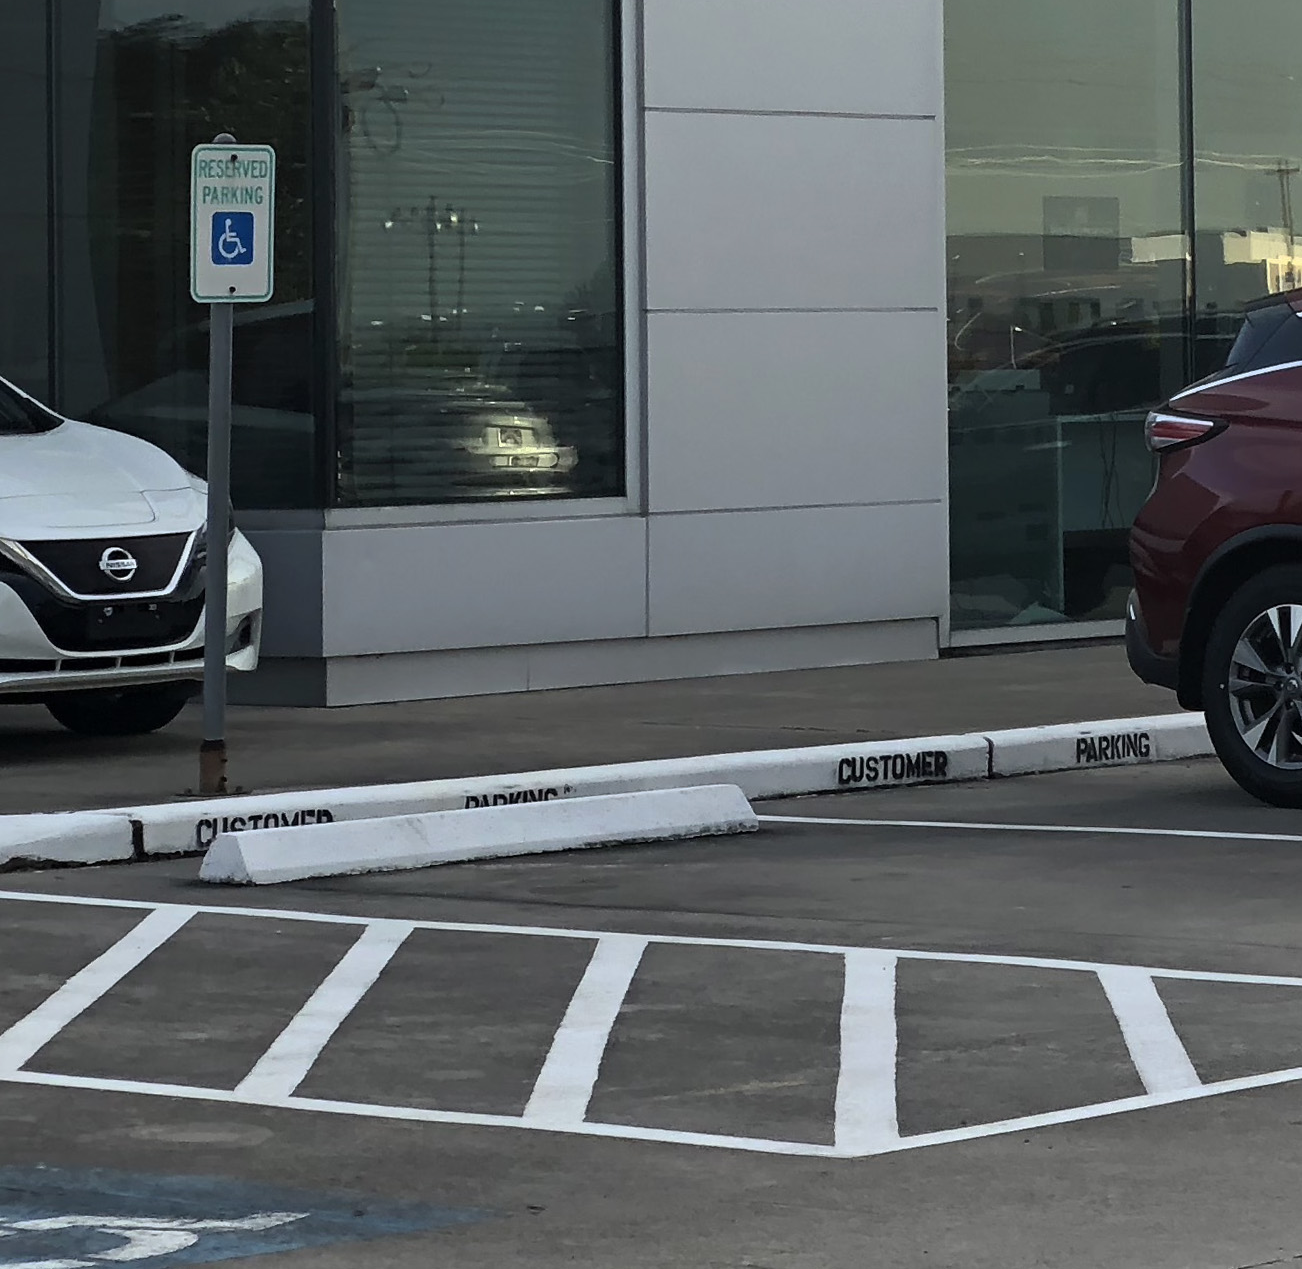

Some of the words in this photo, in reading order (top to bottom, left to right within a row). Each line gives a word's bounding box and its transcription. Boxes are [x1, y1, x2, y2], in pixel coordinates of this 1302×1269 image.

[199, 159, 268, 179] RESERVED
[202, 185, 264, 205] PARKING
[838, 750, 948, 785] CUSTOMER
[1075, 732, 1151, 763] PARKING
